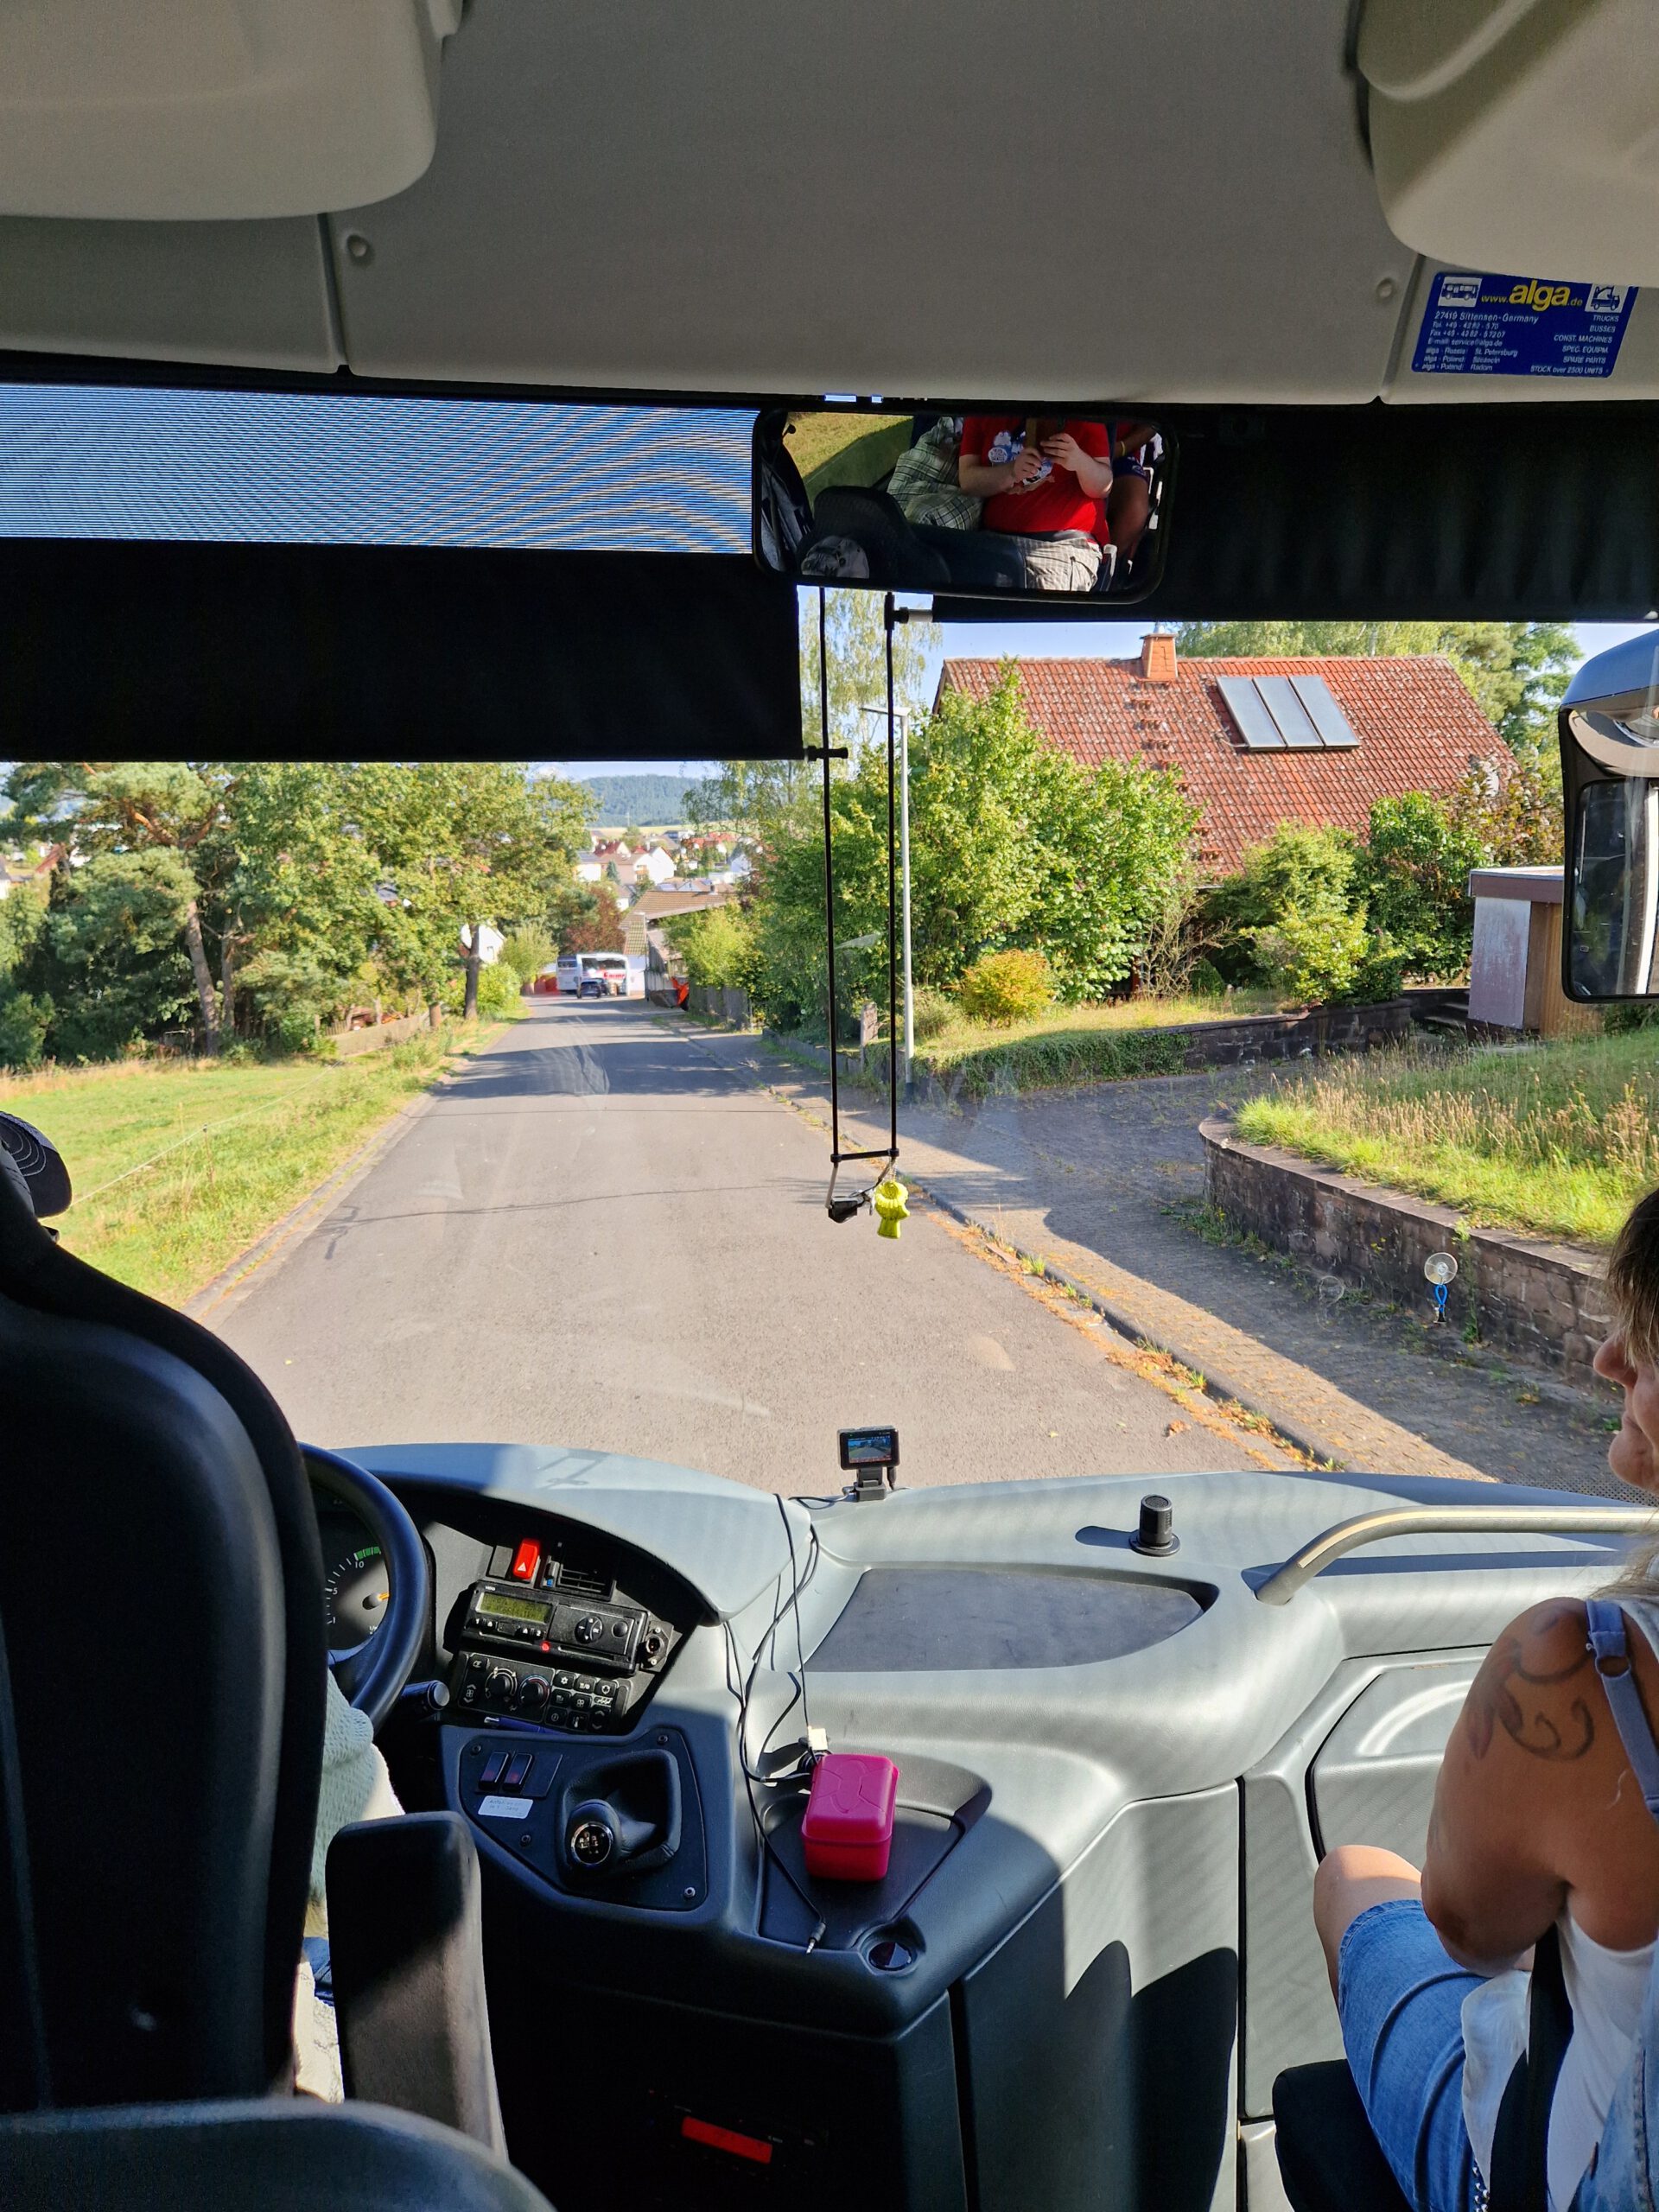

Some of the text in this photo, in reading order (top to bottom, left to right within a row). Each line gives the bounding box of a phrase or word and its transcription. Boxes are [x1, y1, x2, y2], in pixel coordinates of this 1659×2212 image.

[1434, 310, 1458, 321] 27419
[1592, 314, 1620, 323] TRUCKS
[1589, 324, 1617, 334] BUSSES
[1578, 335, 1613, 344] MACHINES
[1562, 355, 1606, 365] SPARE PARTS
[1529, 364, 1552, 373] STOCK
[1567, 365, 1584, 374] 2500
[1584, 366, 1604, 375] UNITS
[354, 1560, 365, 1569] 10
